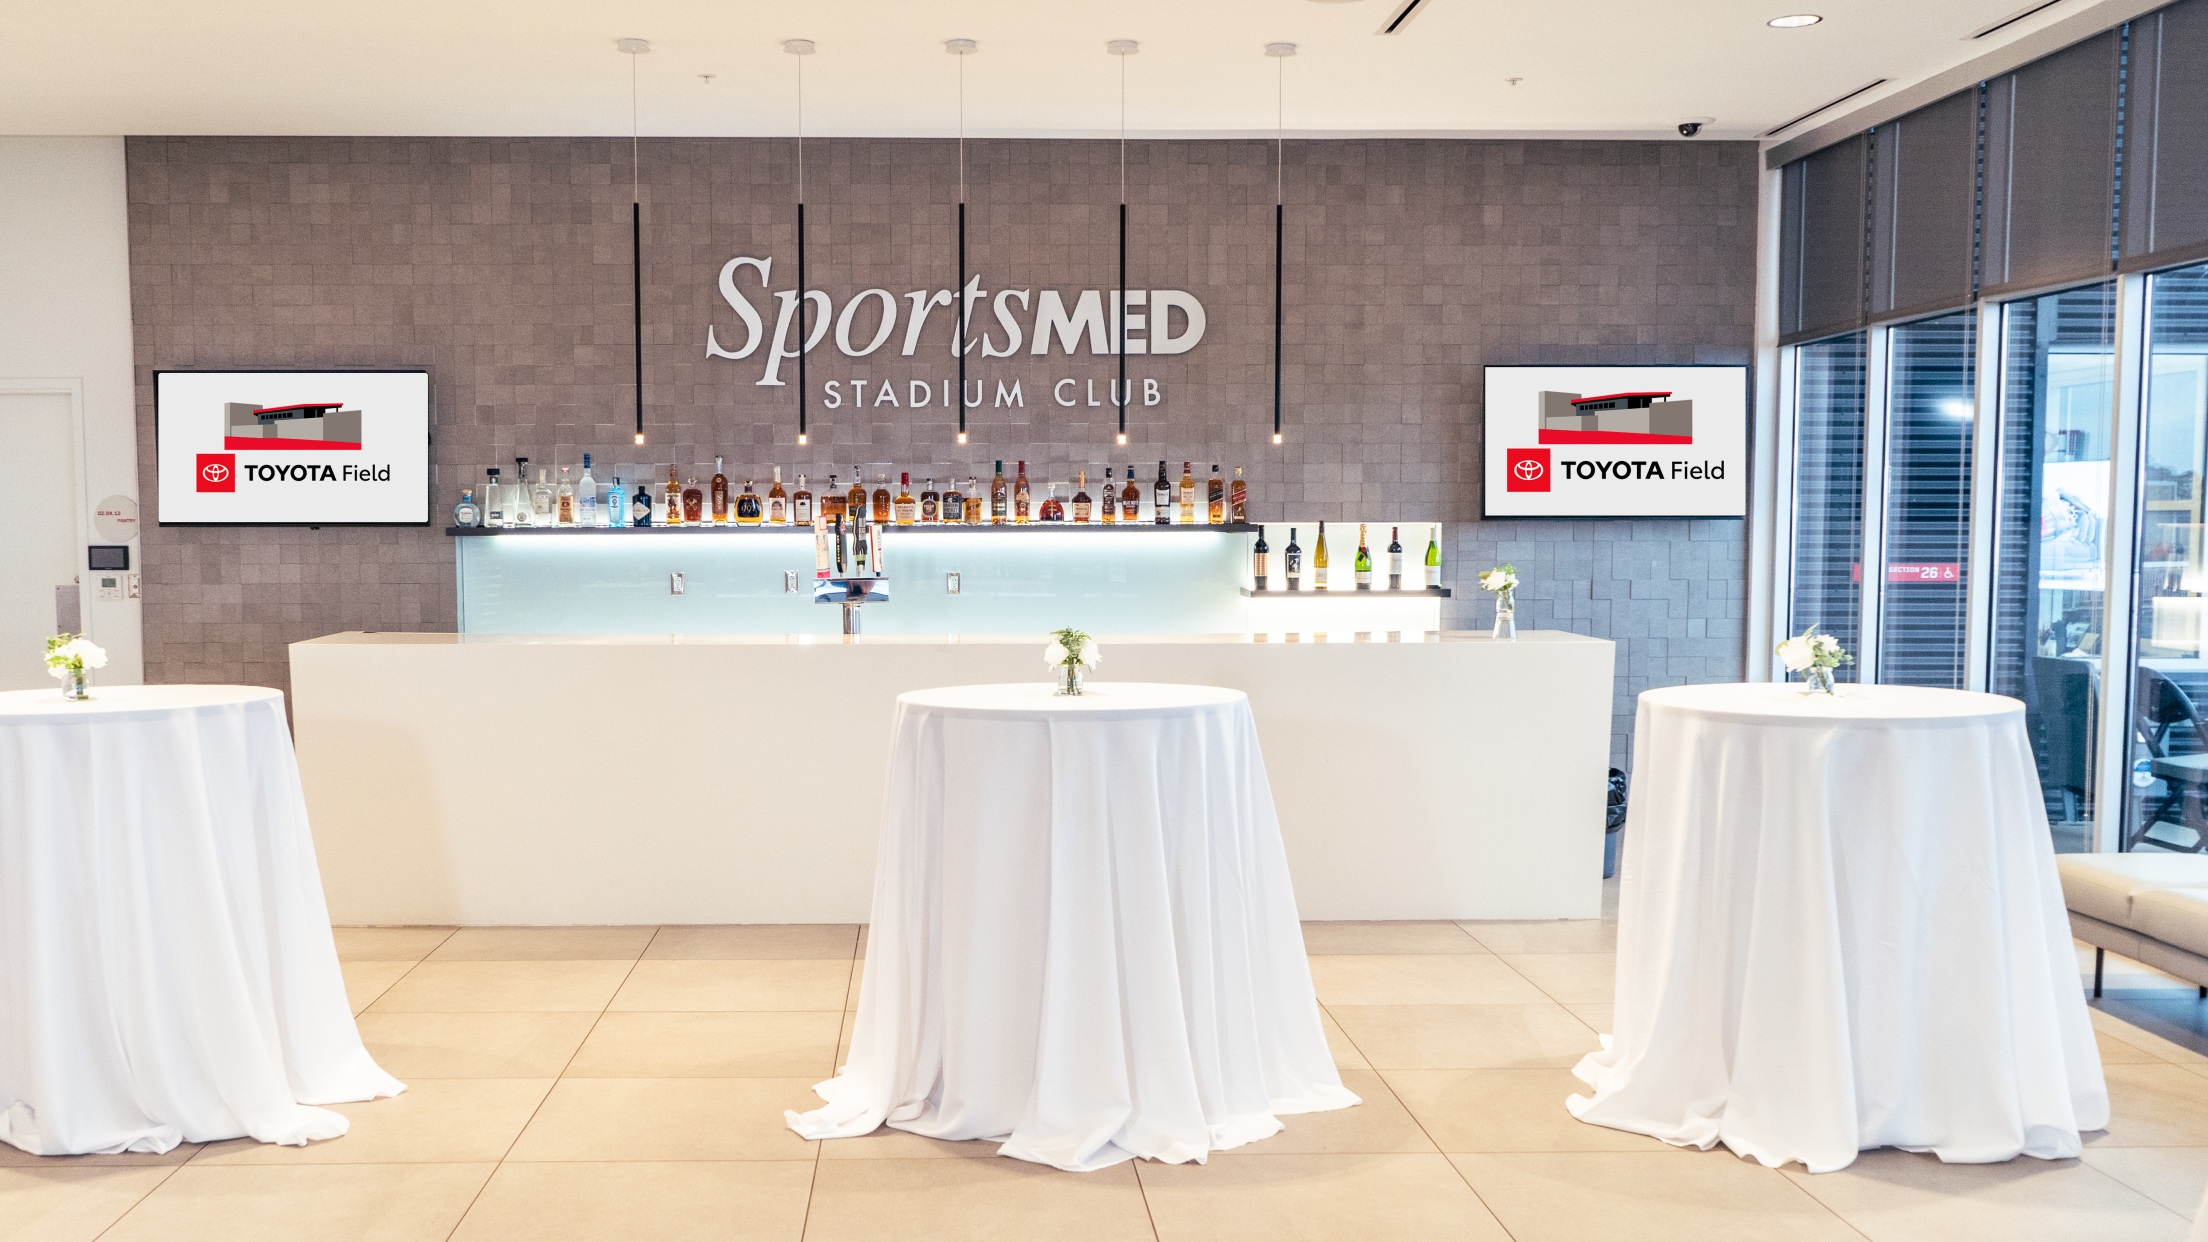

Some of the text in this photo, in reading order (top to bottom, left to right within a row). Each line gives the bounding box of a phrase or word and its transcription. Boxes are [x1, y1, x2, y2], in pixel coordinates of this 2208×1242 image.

[705, 256, 1207, 386] SportsMED
[823, 378, 1161, 409] STADIUM CLUB
[244, 464, 391, 482] TOYOTA Field
[1561, 460, 1725, 480] TOYOTA Field
[1920, 566, 1939, 579] 26
